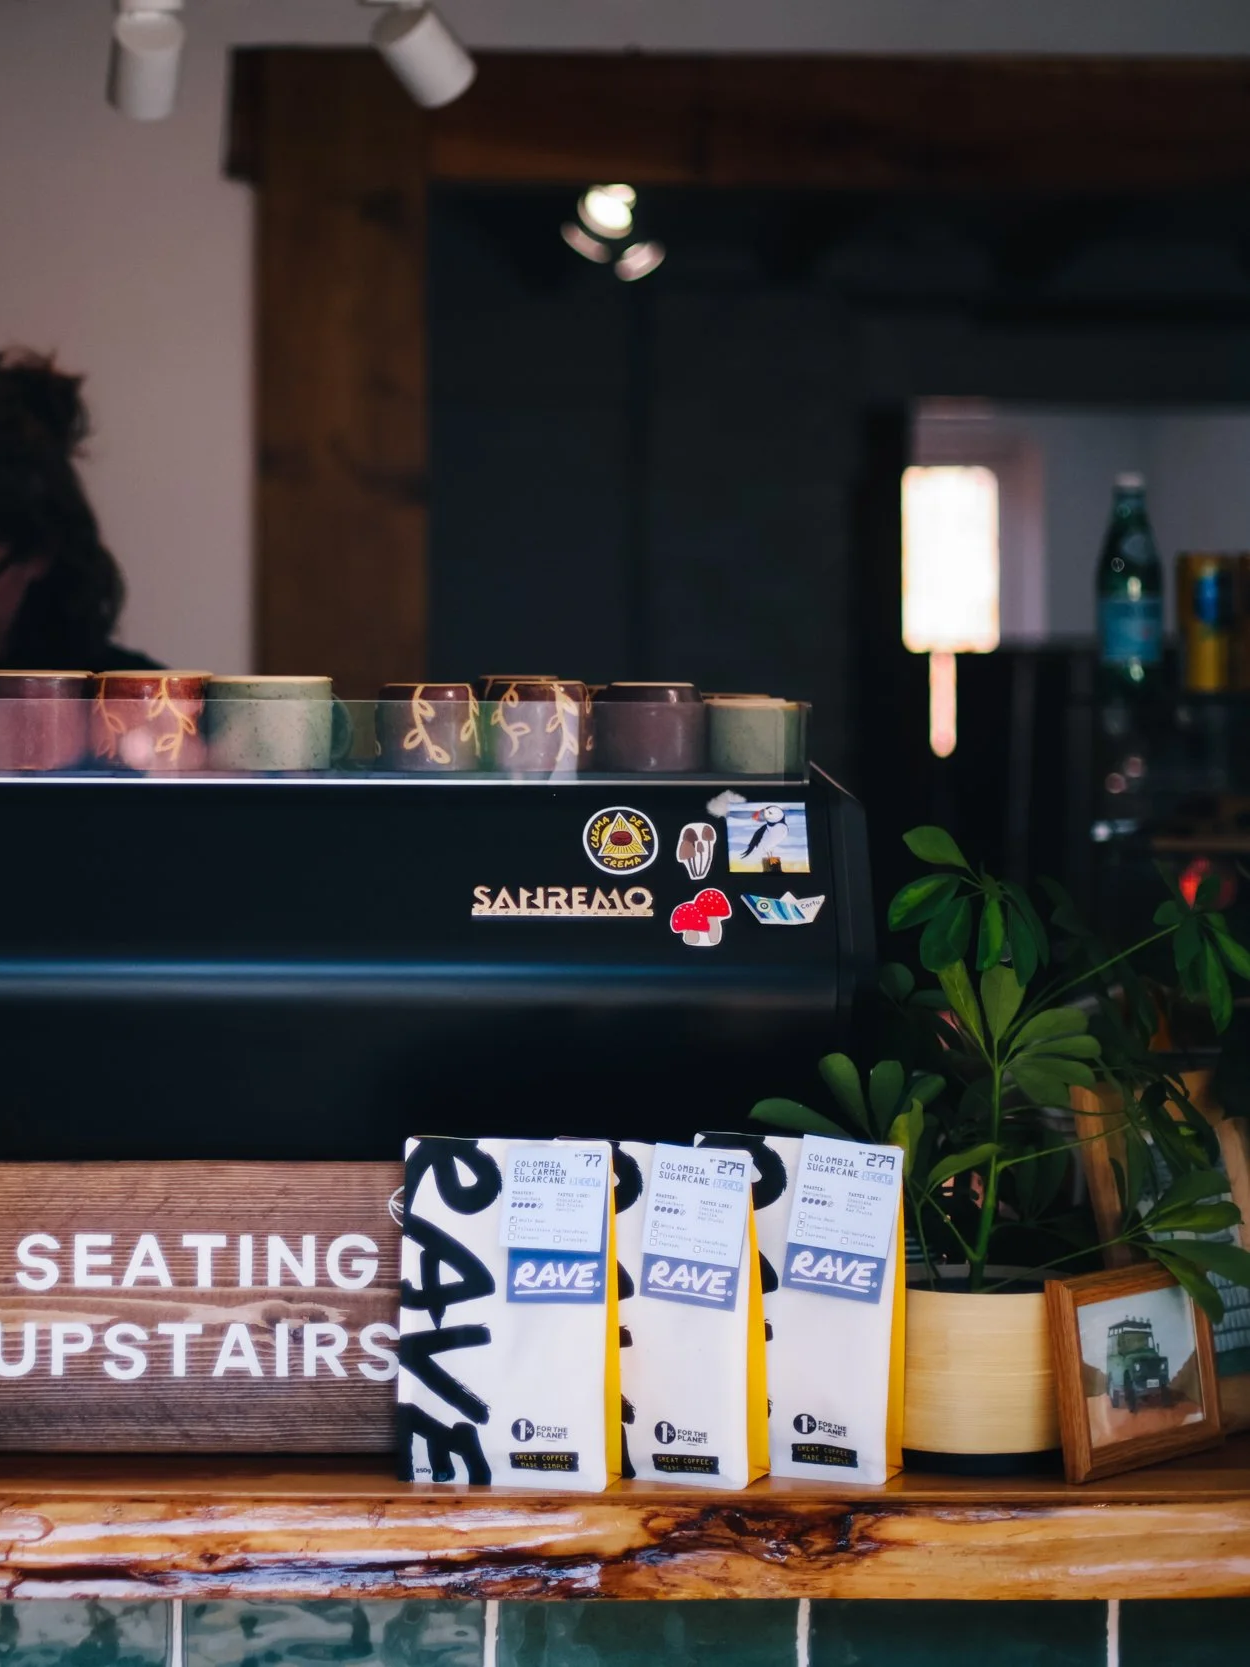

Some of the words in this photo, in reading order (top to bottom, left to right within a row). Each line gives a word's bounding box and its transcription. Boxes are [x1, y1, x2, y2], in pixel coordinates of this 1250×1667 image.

[590, 816, 610, 849] CREMA
[629, 815, 644, 827] DE
[641, 828, 651, 841] LA
[603, 856, 642, 868] CREMA
[472, 885, 654, 910] SANREMO
[515, 1160, 561, 1168] COLOMBIA
[583, 1154, 602, 1168] 77
[660, 1161, 705, 1175] COLOMBIA
[808, 1153, 855, 1168] COLOMBIA
[866, 1152, 896, 1170] 279
[717, 1160, 745, 1177] 279
[806, 1163, 859, 1178] SUGARCANE
[513, 1176, 566, 1184] SUGARCANE
[658, 1171, 710, 1186] SUGARCANE
[15, 1233, 380, 1291] SEATING
[398, 1138, 502, 1485] RAVE
[677, 1428, 692, 1436] FOR
[818, 1420, 833, 1428] FOR
[833, 1423, 847, 1431] THE
